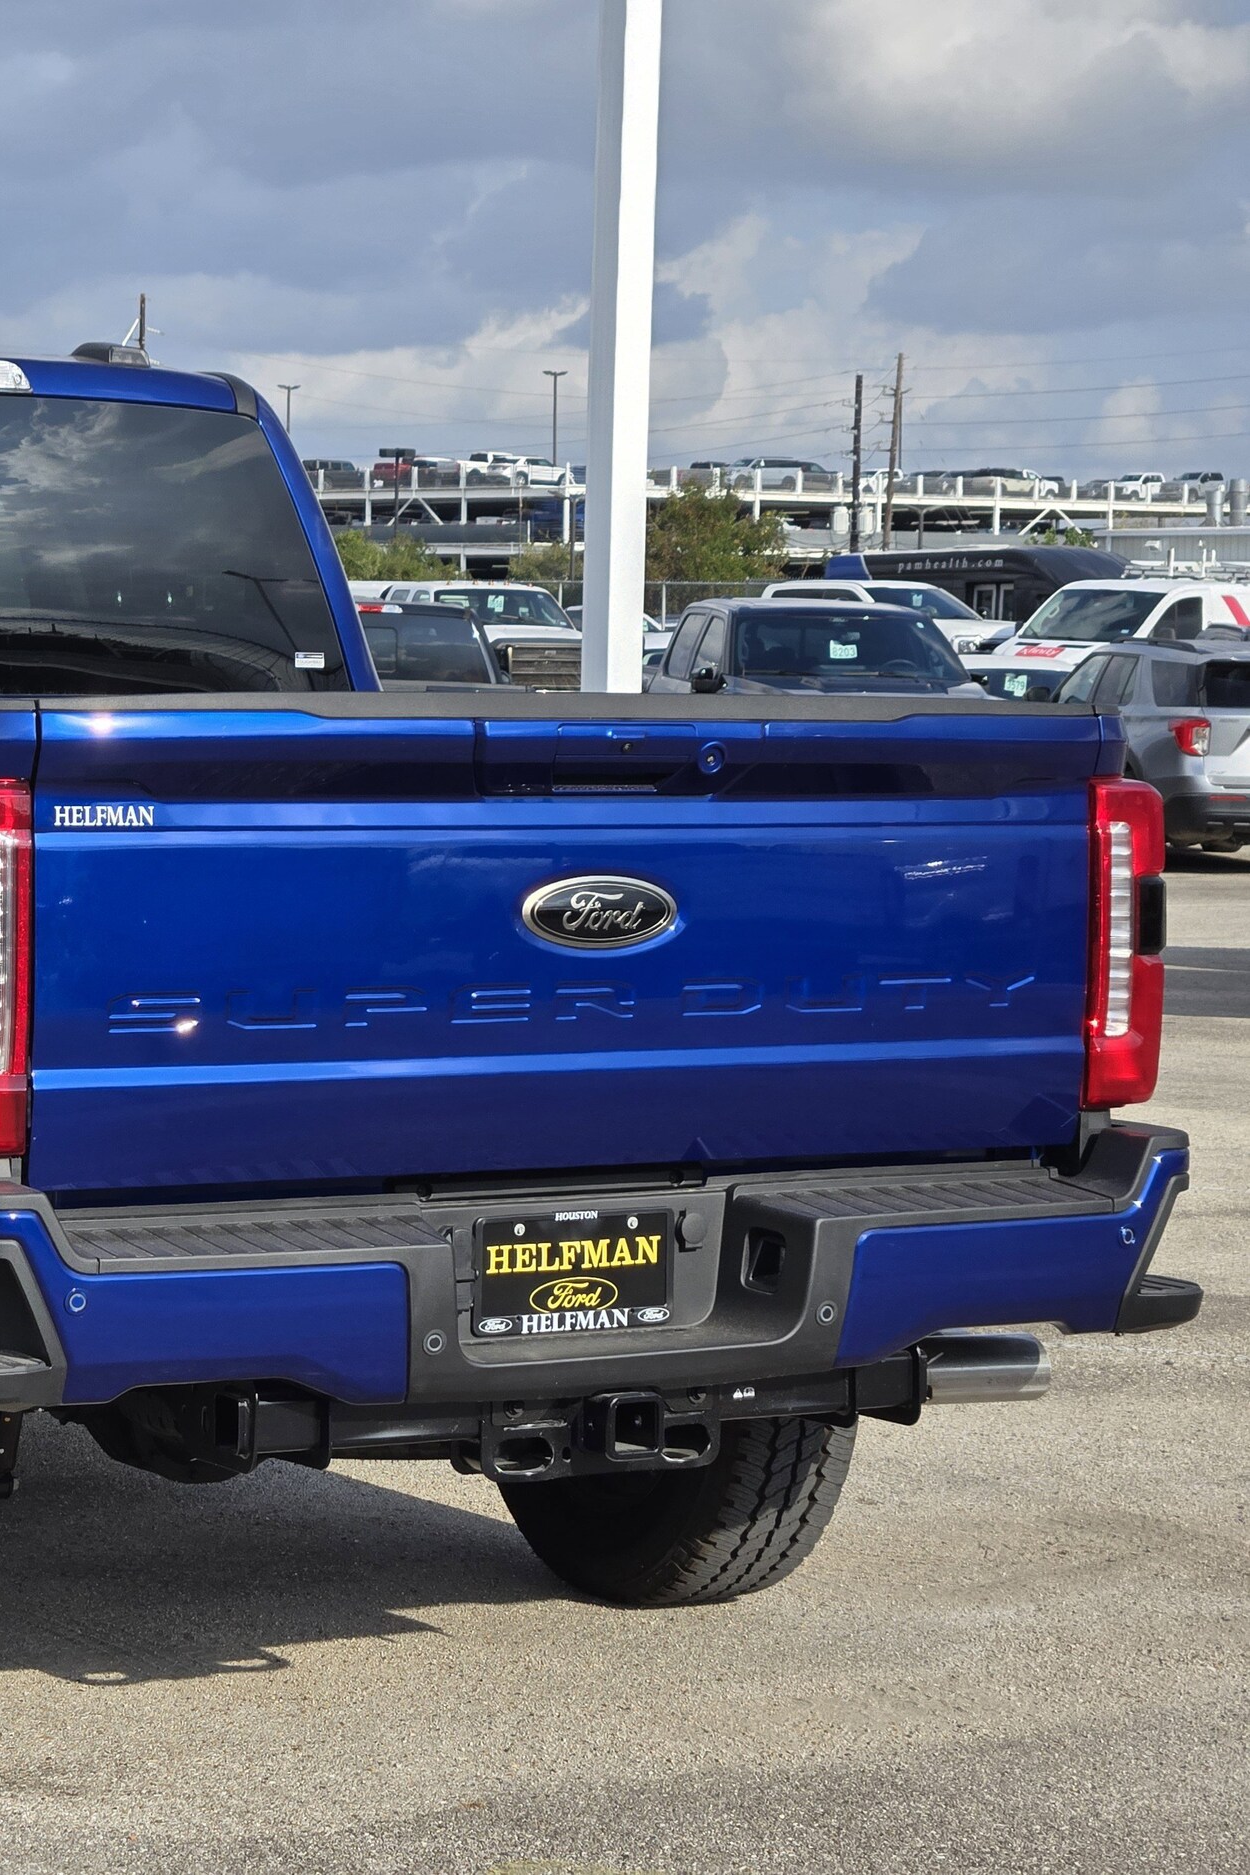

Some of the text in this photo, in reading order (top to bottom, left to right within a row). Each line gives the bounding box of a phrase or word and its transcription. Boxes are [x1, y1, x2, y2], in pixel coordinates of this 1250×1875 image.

[897, 557, 1004, 573] pamhealth.com
[832, 646, 856, 657] 8203
[54, 806, 155, 827] HELFMAN
[562, 891, 646, 931] Ford
[106, 968, 1036, 1035] SUPER DUTY
[554, 1210, 598, 1222] HOUSTON
[485, 1235, 662, 1274] HELFMAN
[547, 1281, 602, 1310] Ford
[521, 1308, 630, 1334] HELFMAN
[643, 1308, 663, 1320] Ford
[484, 1319, 506, 1331] Ford
